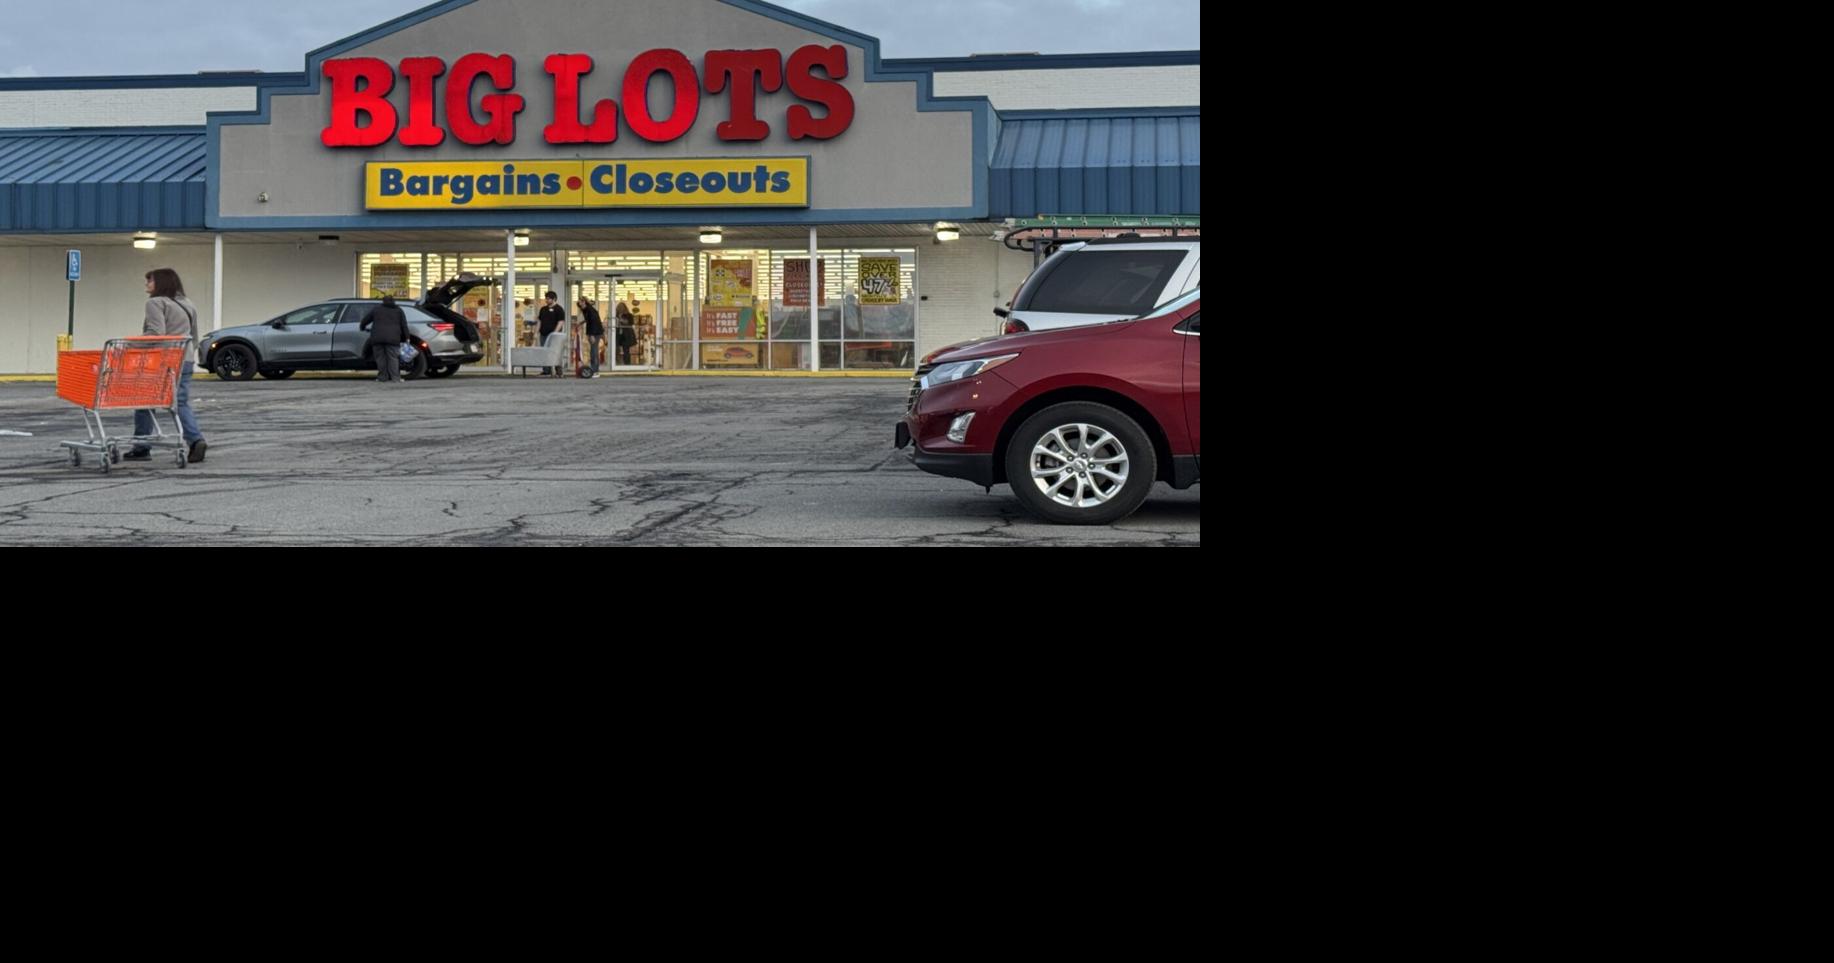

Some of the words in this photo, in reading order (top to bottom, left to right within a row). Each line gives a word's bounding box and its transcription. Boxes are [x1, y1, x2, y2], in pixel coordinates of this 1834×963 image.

[320, 52, 525, 148] BIG
[542, 43, 855, 145] LOTS
[379, 163, 562, 204] Bargains
[589, 164, 791, 194] Closeouts
[861, 263, 898, 272] SAVE
